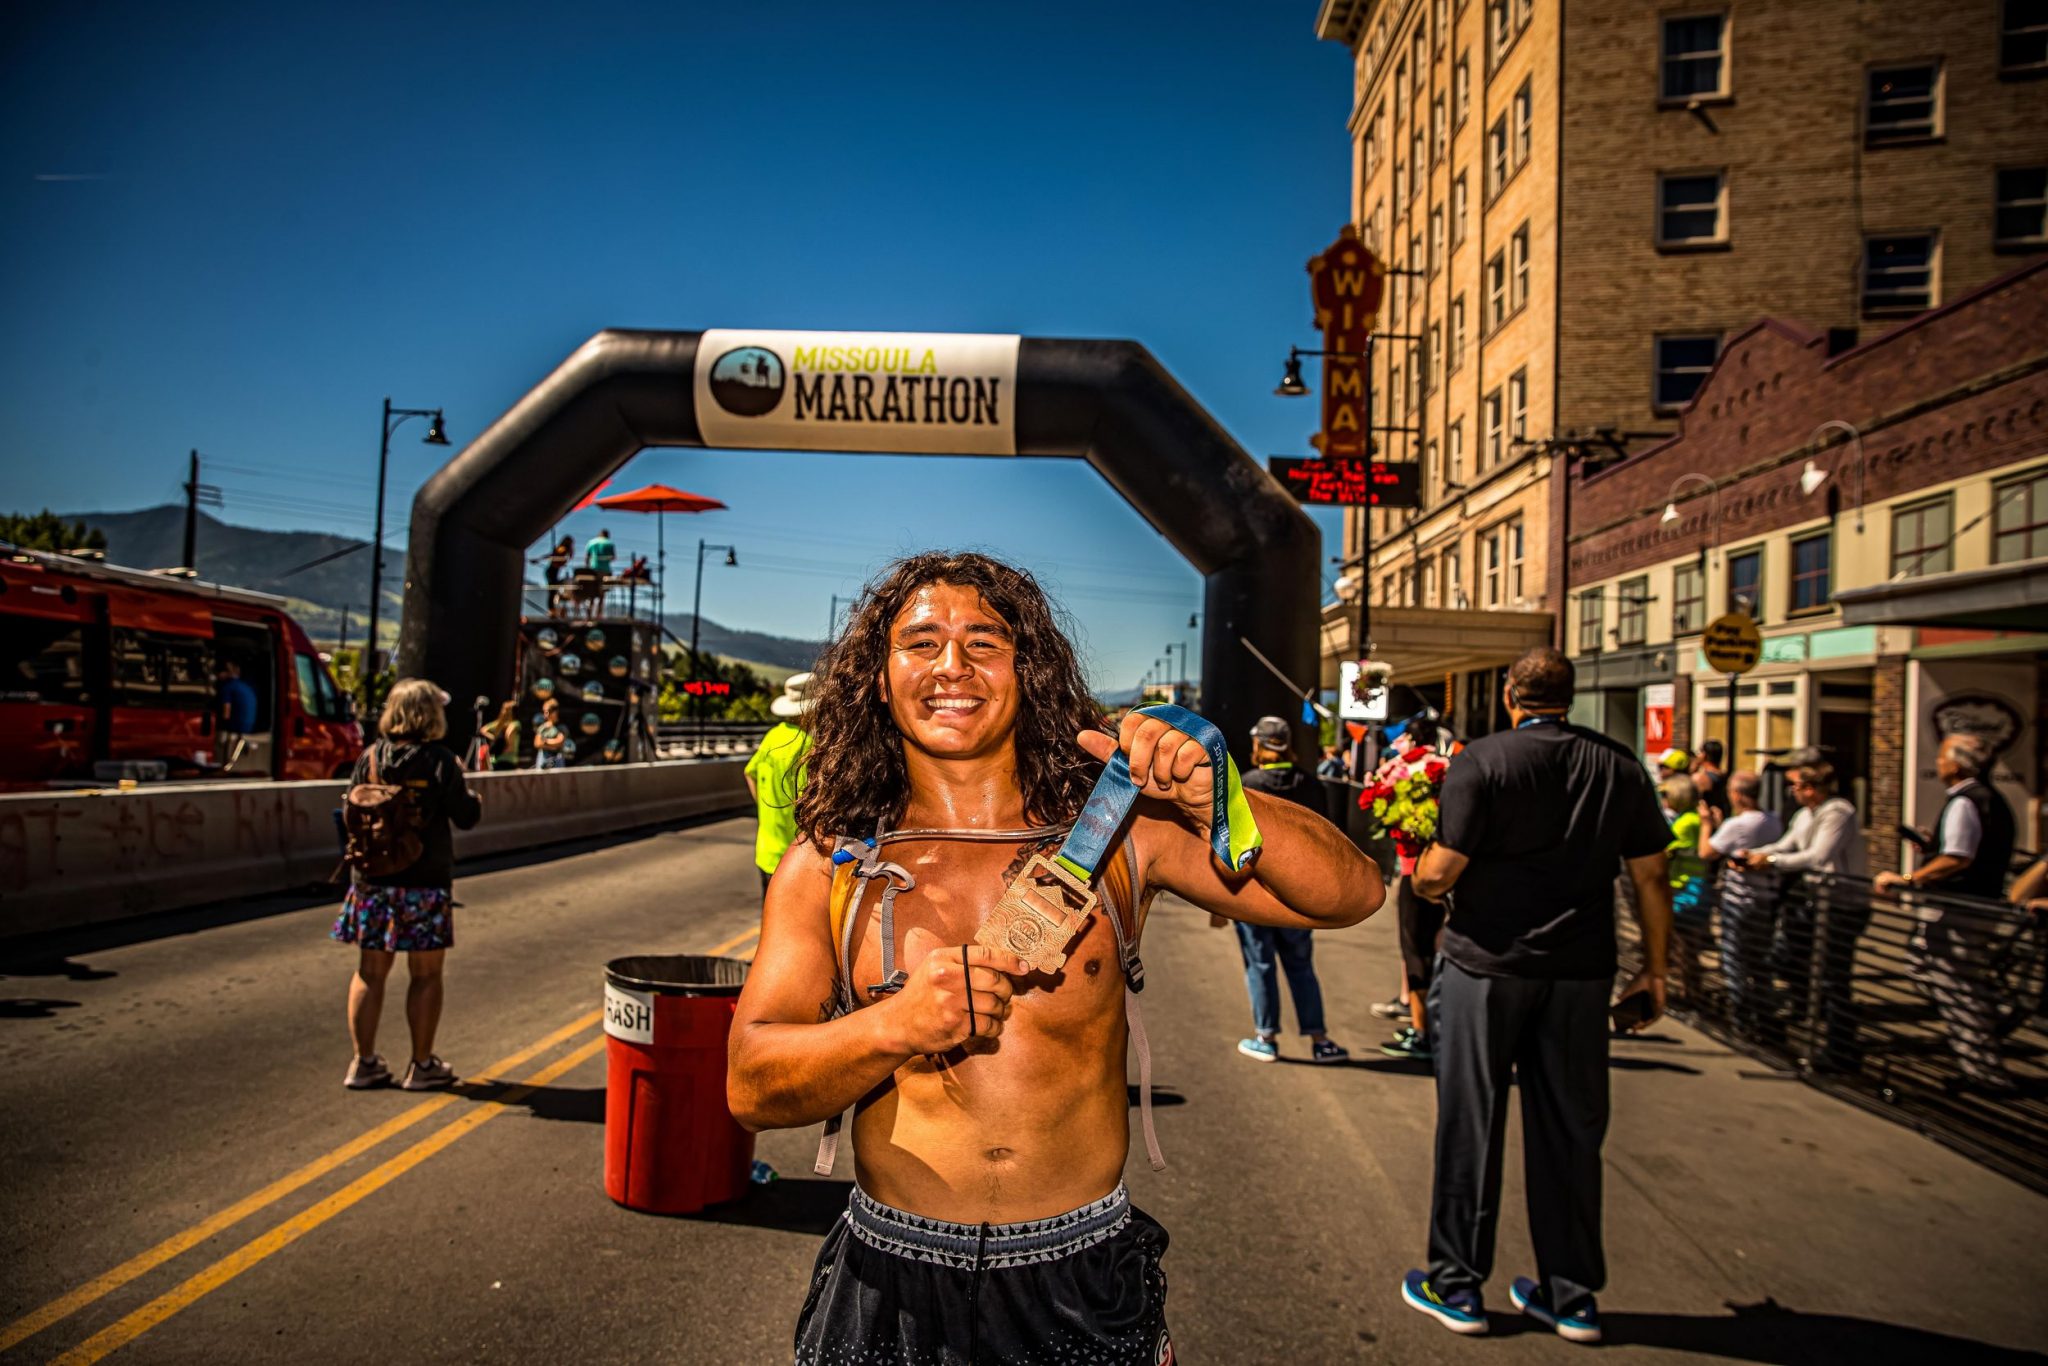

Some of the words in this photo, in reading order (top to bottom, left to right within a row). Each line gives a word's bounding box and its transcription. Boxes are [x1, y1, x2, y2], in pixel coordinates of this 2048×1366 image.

[792, 347, 937, 374] MISSOULA
[1331, 269, 1365, 431] WILMA
[794, 374, 999, 424] MARATHON
[1213, 742, 1225, 774] PLACE
[1216, 799, 1225, 822] LAST
